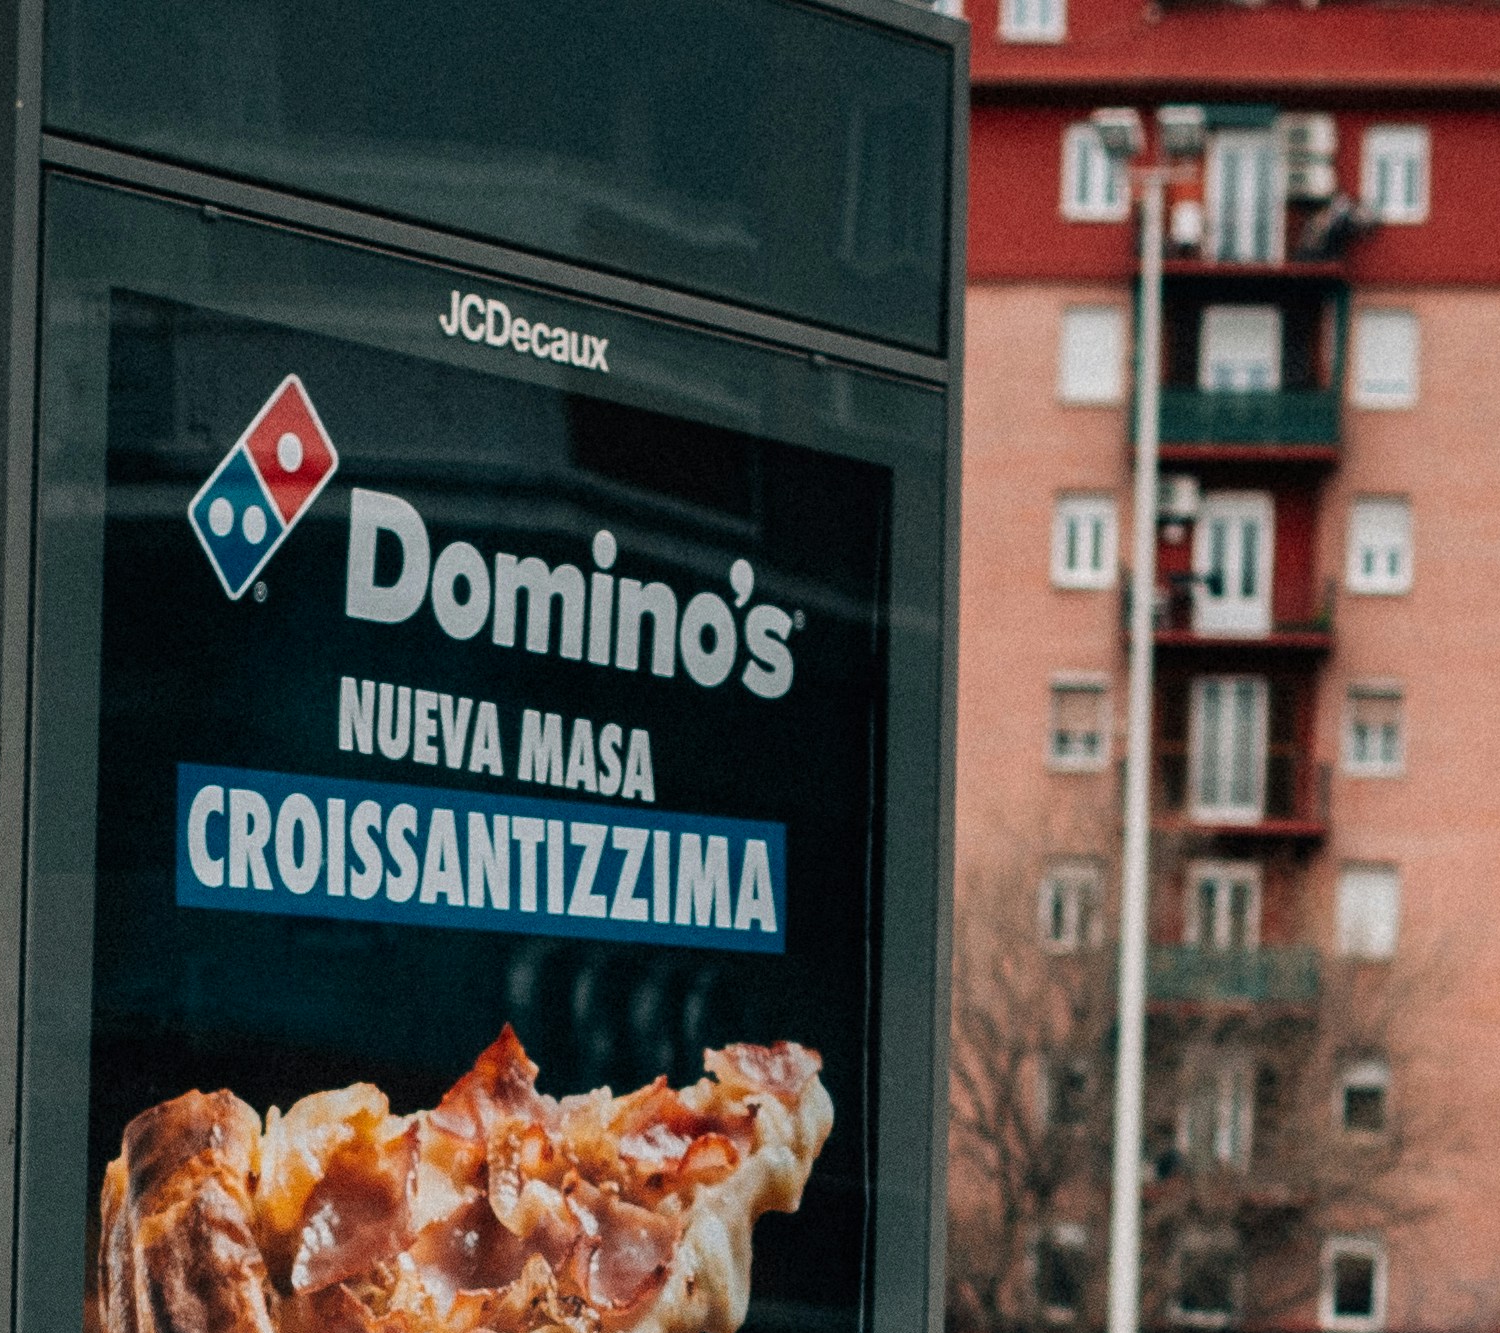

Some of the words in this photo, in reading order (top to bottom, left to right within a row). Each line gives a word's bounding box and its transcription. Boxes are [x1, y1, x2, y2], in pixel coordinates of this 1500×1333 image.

[439, 290, 609, 372] JCDecaux
[345, 488, 796, 699] Domino's
[339, 676, 504, 777] NUEVA
[518, 709, 656, 802] MASA
[187, 784, 778, 933] CROISSANTIZZIMA
